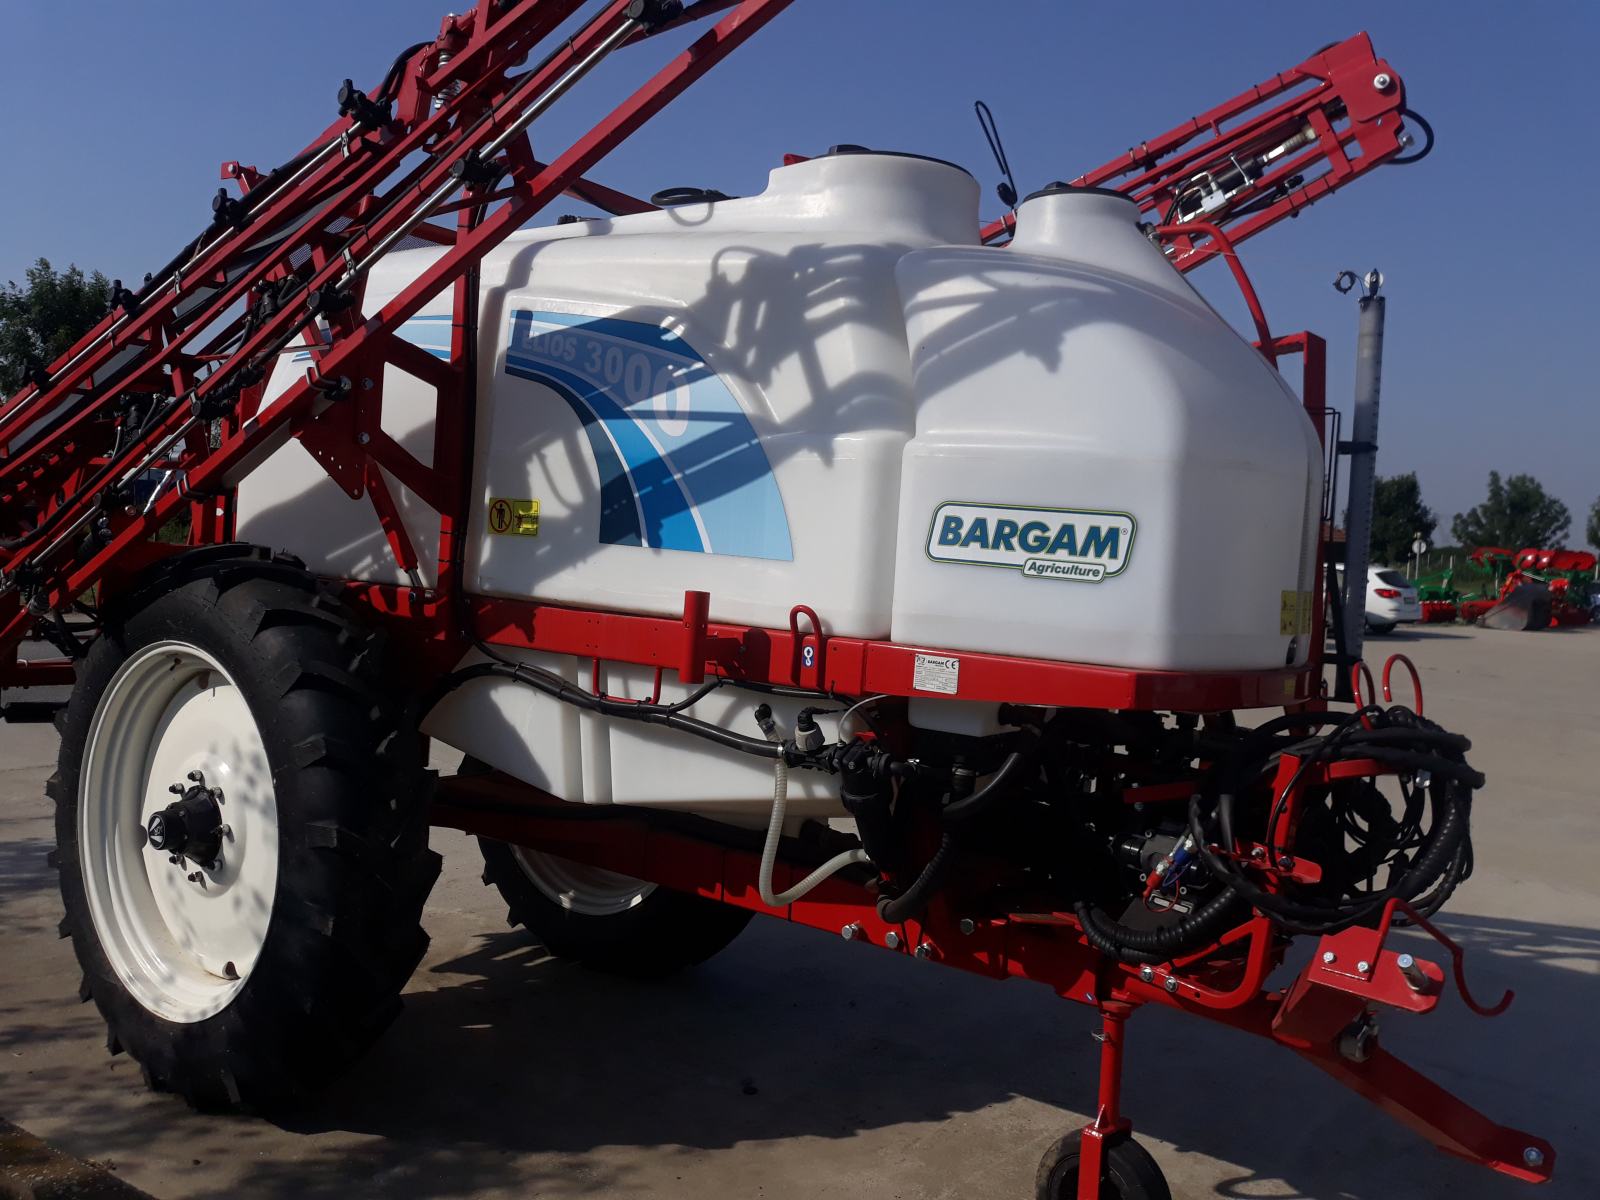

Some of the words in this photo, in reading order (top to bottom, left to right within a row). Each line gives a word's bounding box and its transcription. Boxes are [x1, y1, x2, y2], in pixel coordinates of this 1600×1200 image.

[585, 340, 691, 437] 3000
[938, 515, 1121, 560] BARGAM
[1027, 561, 1100, 578] Agriculture
